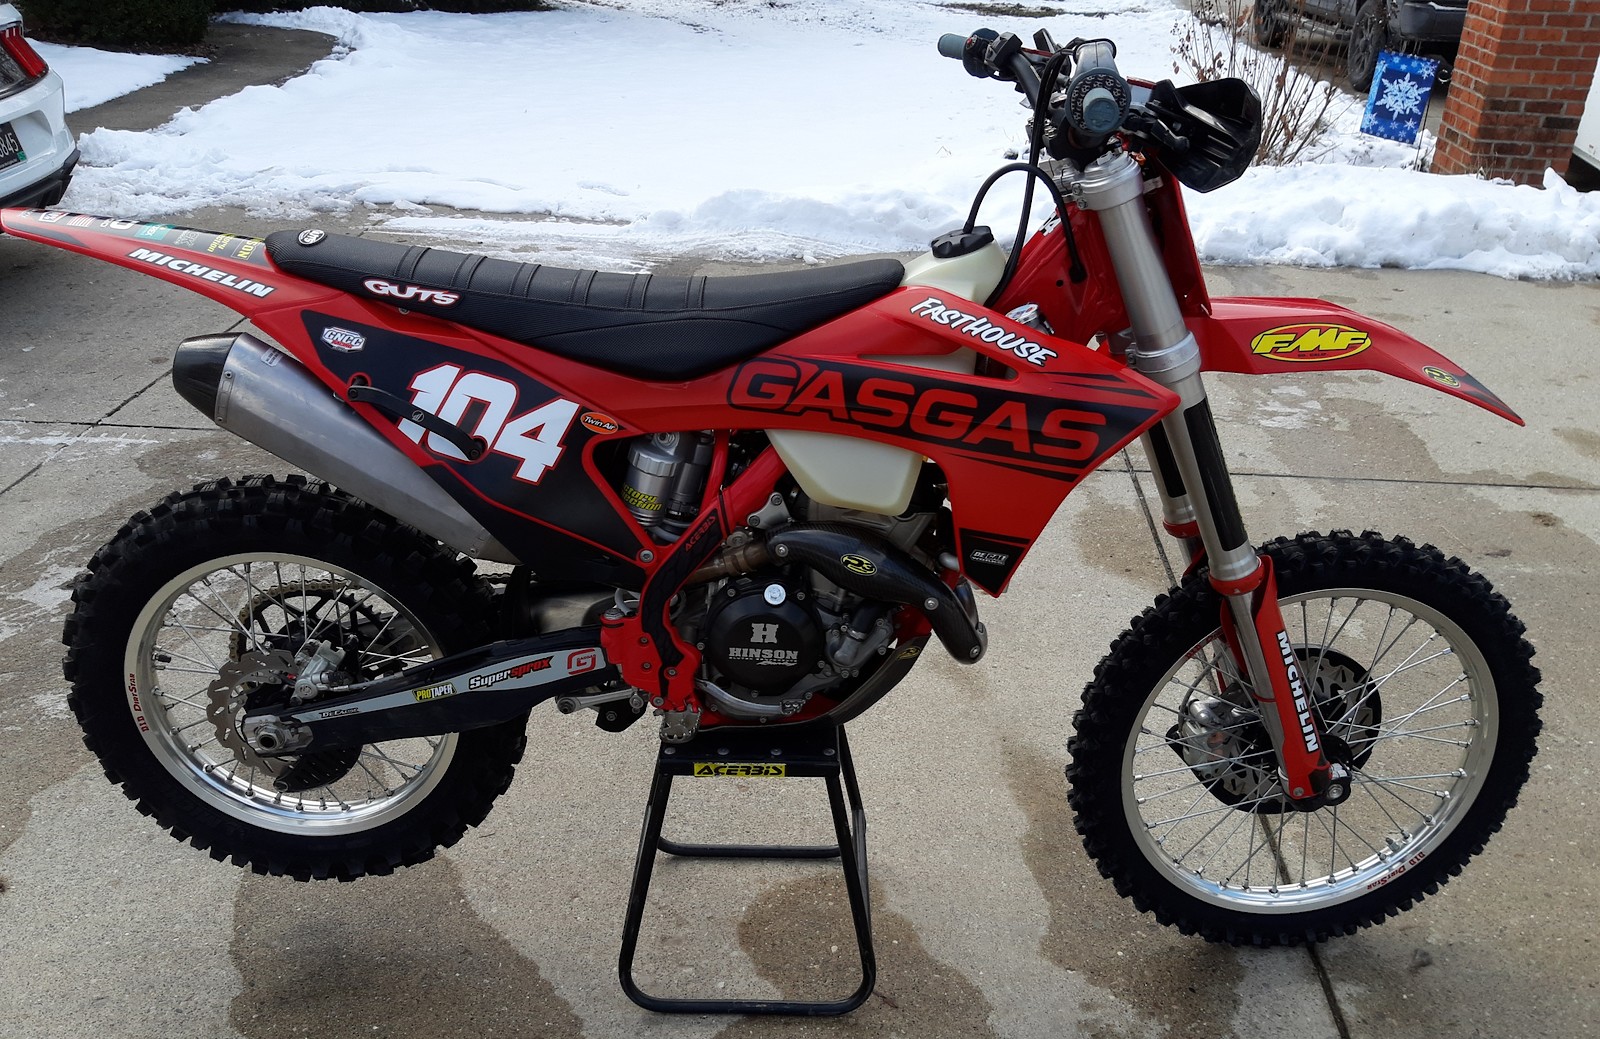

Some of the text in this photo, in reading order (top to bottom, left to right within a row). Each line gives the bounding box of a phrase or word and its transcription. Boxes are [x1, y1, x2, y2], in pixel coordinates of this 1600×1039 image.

[129, 249, 275, 298] MICHELIN
[364, 280, 459, 305] GUTS
[324, 330, 363, 346] GNCC
[911, 298, 1058, 367] FASTHOUSE
[1252, 328, 1368, 354] FMF
[398, 364, 581, 483] 104
[584, 415, 616, 431] Twin Air
[730, 362, 1107, 461] GASGAS
[750, 623, 779, 643] H
[729, 648, 798, 659] HINSON
[469, 657, 551, 689] Supersprox
[1277, 631, 1319, 752] MICHELIN
